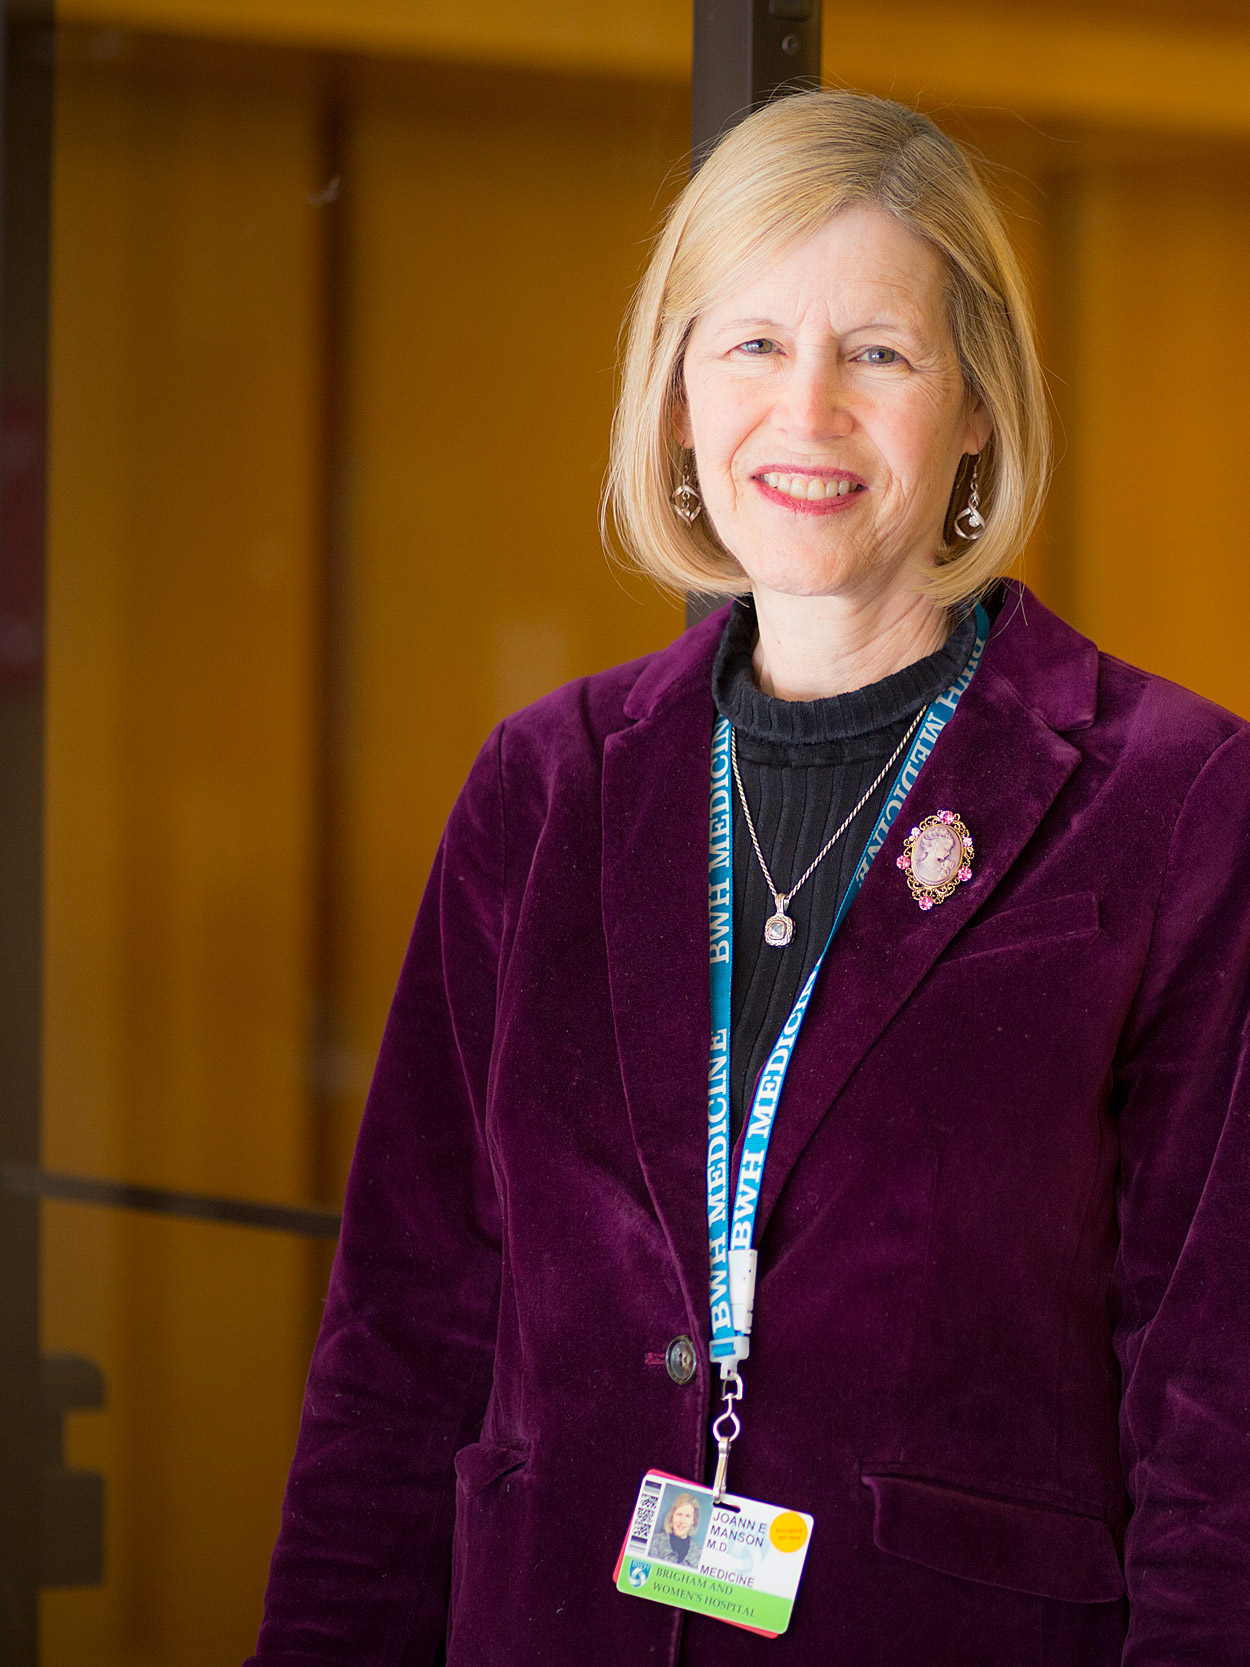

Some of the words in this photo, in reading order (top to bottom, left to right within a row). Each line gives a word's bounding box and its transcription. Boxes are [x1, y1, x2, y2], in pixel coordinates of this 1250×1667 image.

[709, 716, 730, 874] MEDICIN
[709, 878, 730, 964] BWH
[748, 957, 822, 1139] MEDICIN
[707, 1027, 728, 1228] MEDICINE
[733, 1149, 765, 1250] BWH
[709, 1231, 731, 1334] BWH
[706, 1538, 730, 1554] M.D.
[710, 1524, 765, 1548] MANSON
[712, 1511, 756, 1531] JOANN
[758, 1522, 767, 1535] E
[653, 1581, 702, 1603] WOMEN'S
[704, 1596, 756, 1618] HOSPITAL
[656, 1567, 708, 1589] BRIGHAM
[709, 1582, 734, 1596] AND
[699, 1564, 755, 1588] MEDICINE
